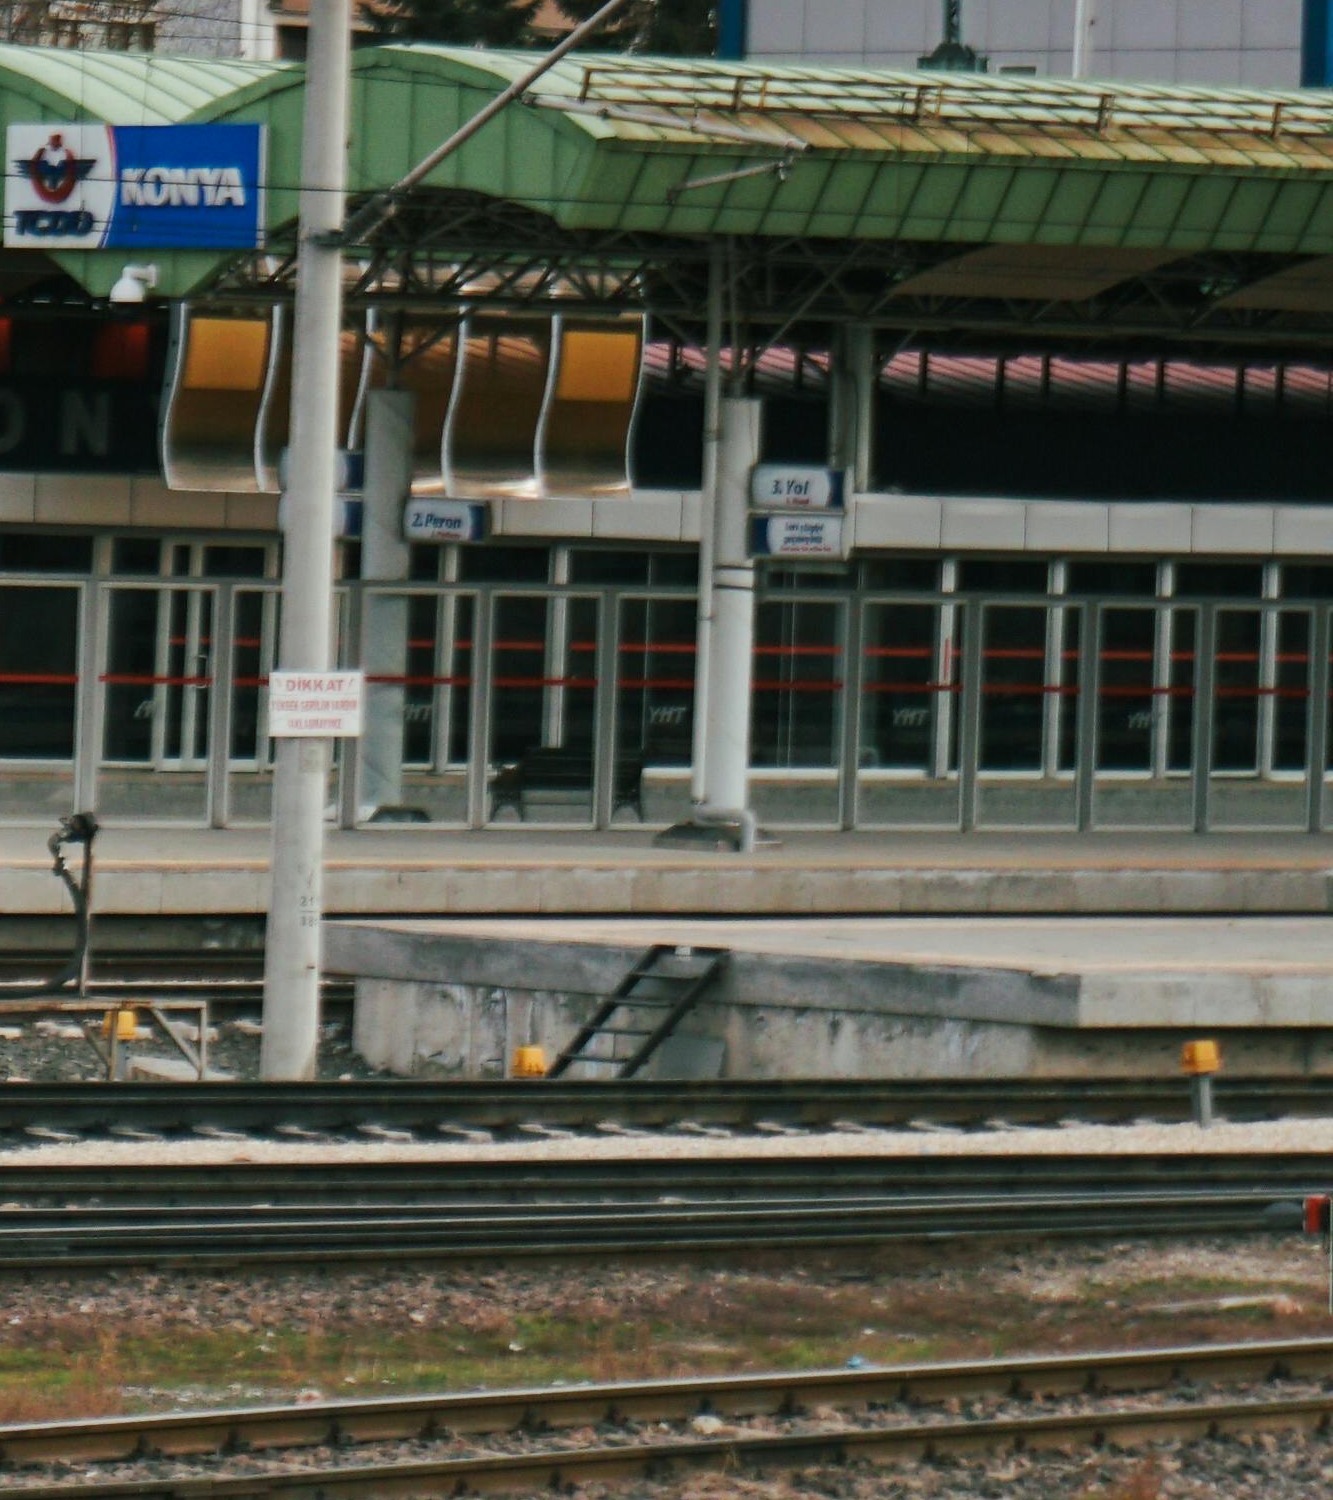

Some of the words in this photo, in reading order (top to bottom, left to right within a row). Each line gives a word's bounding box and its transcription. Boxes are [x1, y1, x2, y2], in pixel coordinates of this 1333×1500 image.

[120, 167, 246, 207] KONYA
[14, 210, 95, 237] TCDD
[786, 479, 810, 496] Yol
[424, 511, 462, 529] Peron
